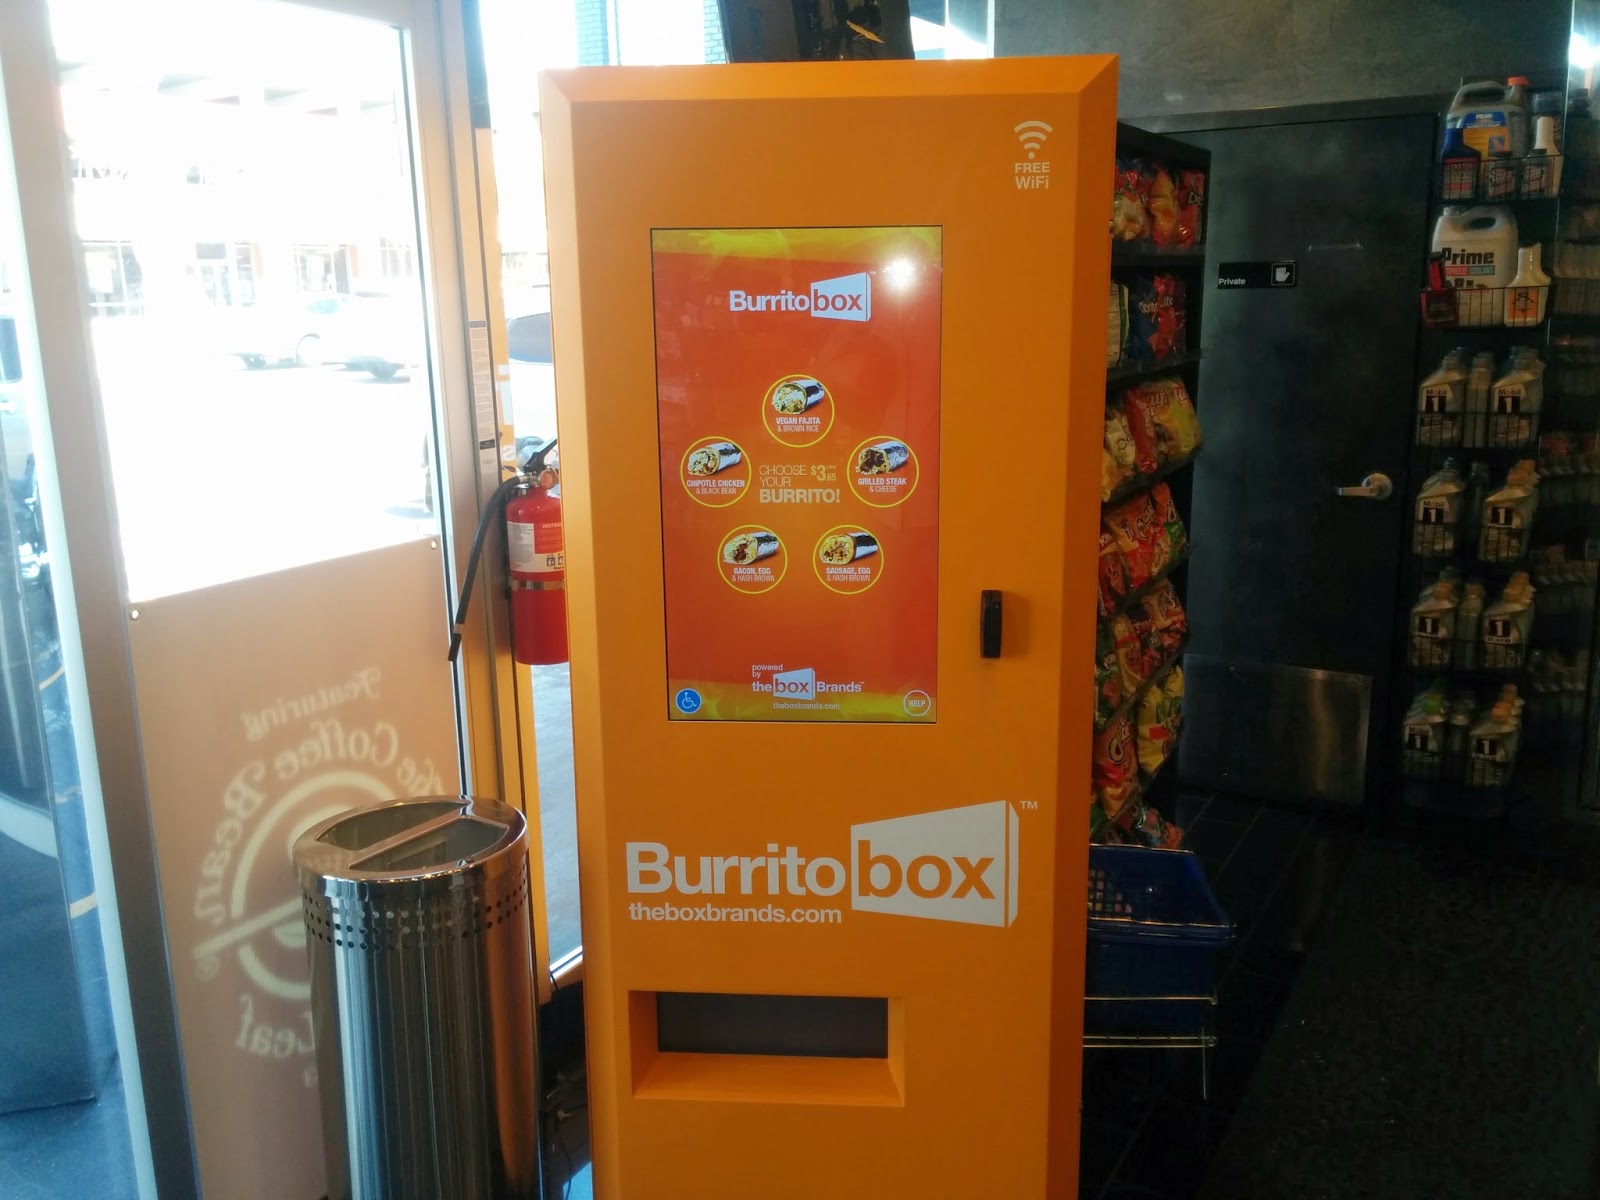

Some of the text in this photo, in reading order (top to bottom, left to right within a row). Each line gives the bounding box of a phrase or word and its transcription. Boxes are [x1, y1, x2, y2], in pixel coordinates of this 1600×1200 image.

[1014, 161, 1050, 174] FREE
[1014, 175, 1049, 190] WiFi
[1442, 247, 1495, 265] Prime
[1218, 277, 1246, 285] Private
[775, 416, 821, 425] VEGAN FAJITA
[758, 464, 807, 476] CHOOSE
[686, 479, 745, 487] CHIPOTLE CHICKEN
[759, 476, 791, 487] YOUR
[857, 477, 907, 486] GRILLED STEAK
[759, 488, 840, 504] BURRITO!
[733, 567, 771, 576] BACON, EGG
[825, 567, 871, 576] SAUSAGE, EGG
[752, 678, 862, 693] the box Brands
[773, 702, 840, 710] theboxbrands.com
[908, 699, 926, 708] HELP
[628, 902, 842, 924] theboxbrands.com
